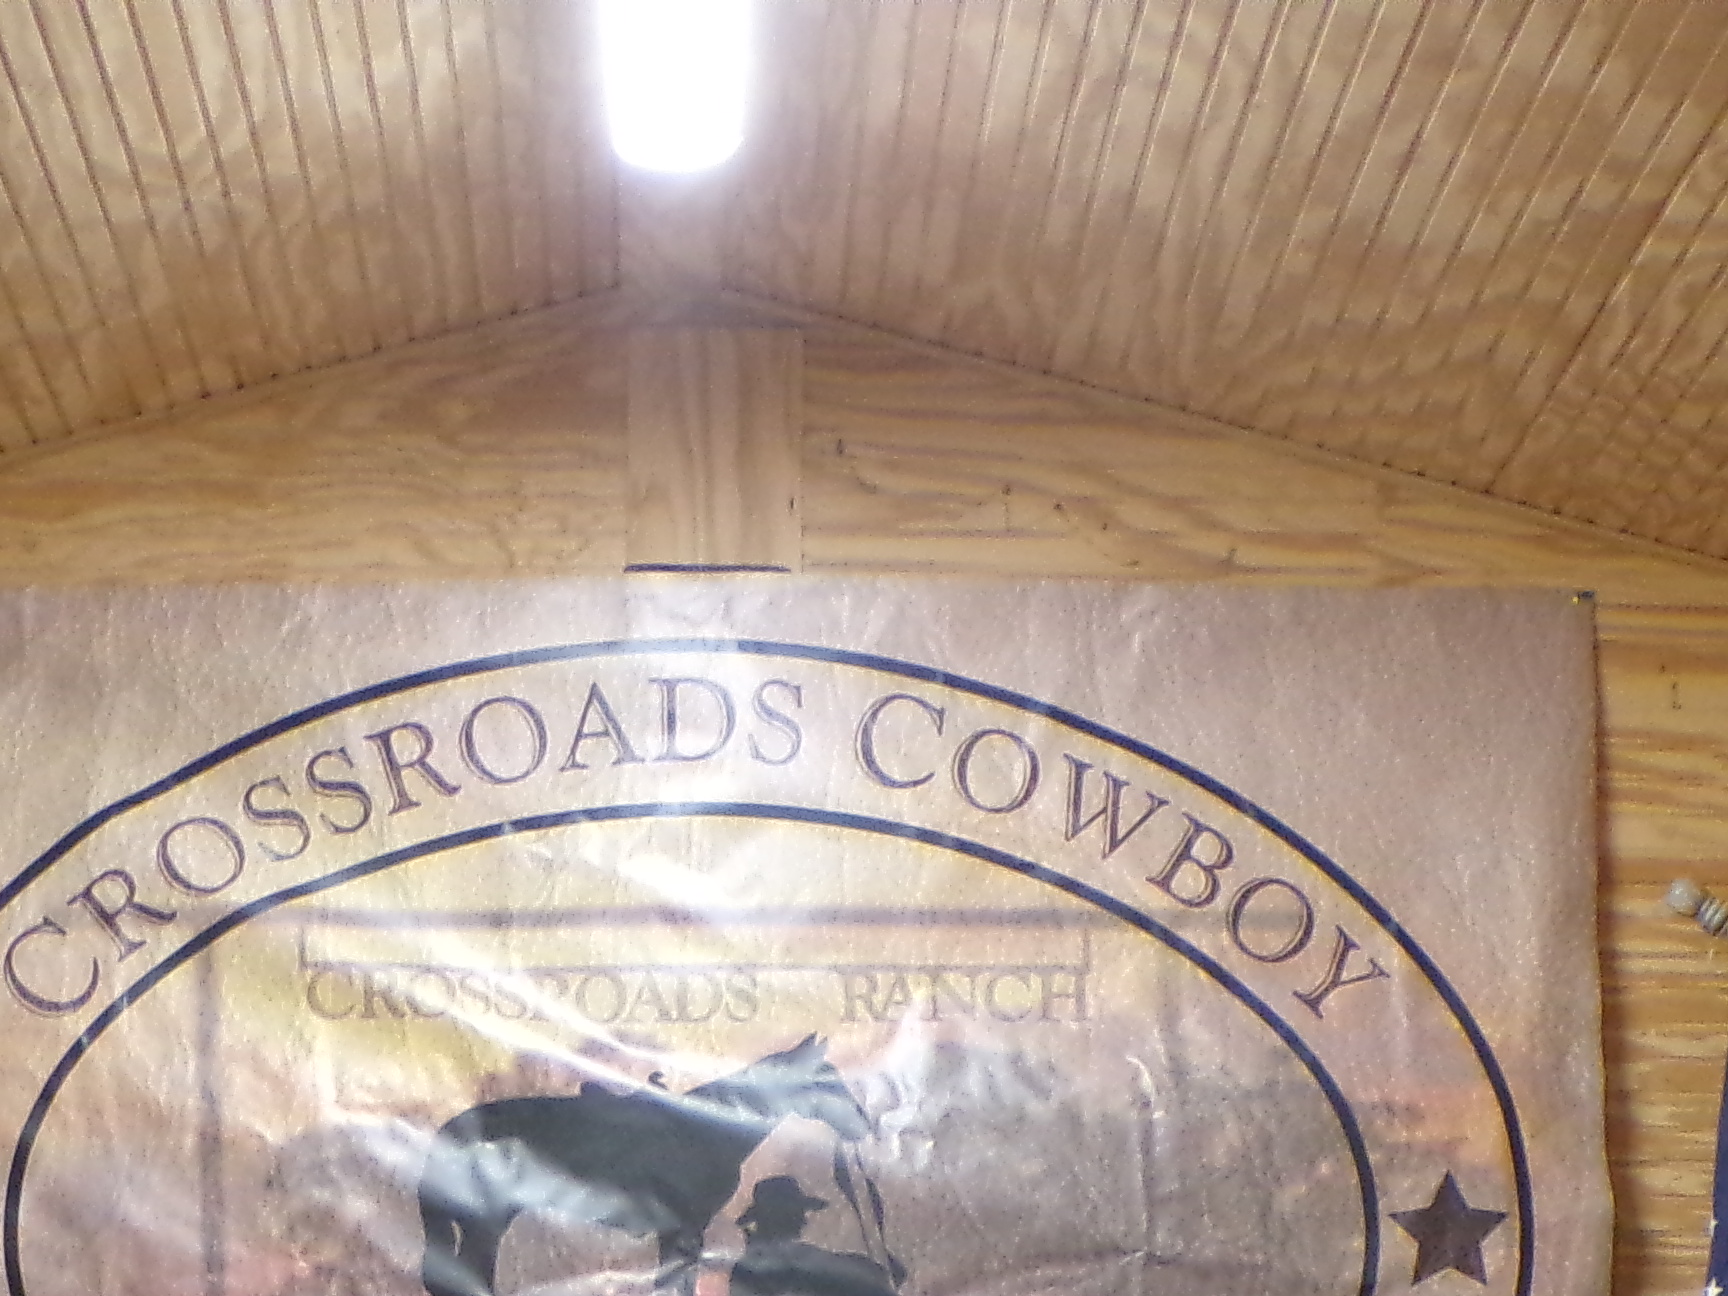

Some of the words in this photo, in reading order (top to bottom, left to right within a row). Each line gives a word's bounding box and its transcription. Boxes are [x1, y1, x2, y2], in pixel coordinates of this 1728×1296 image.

[3, 677, 803, 1014] CROSSROADS
[855, 693, 1390, 1019] COWBOY
[840, 972, 1091, 1022] RANCH
